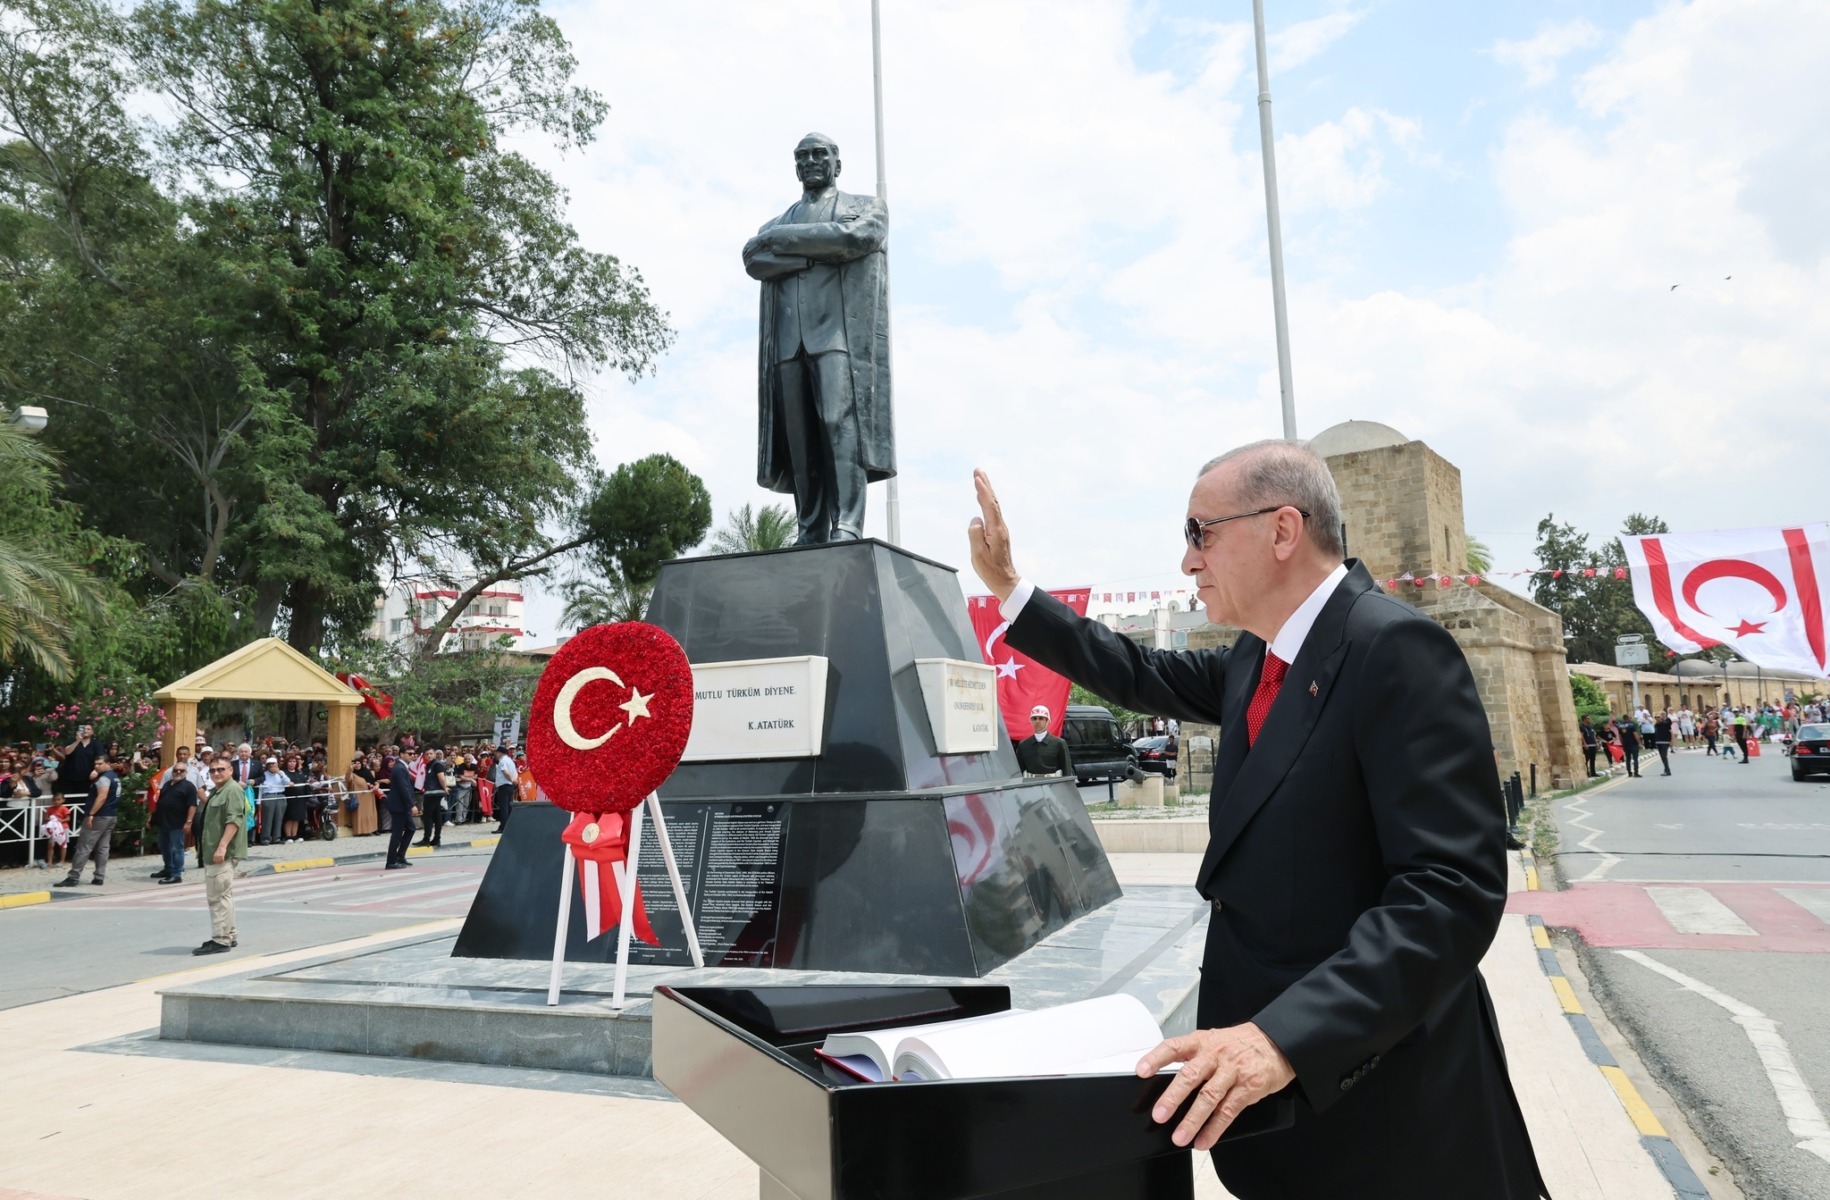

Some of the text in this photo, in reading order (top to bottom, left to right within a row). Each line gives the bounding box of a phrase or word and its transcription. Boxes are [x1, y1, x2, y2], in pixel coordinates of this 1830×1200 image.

[695, 690, 722, 700] MUTLU
[726, 686, 761, 698] TÜRKÜM
[748, 718, 795, 730] K.ATATÜRK
